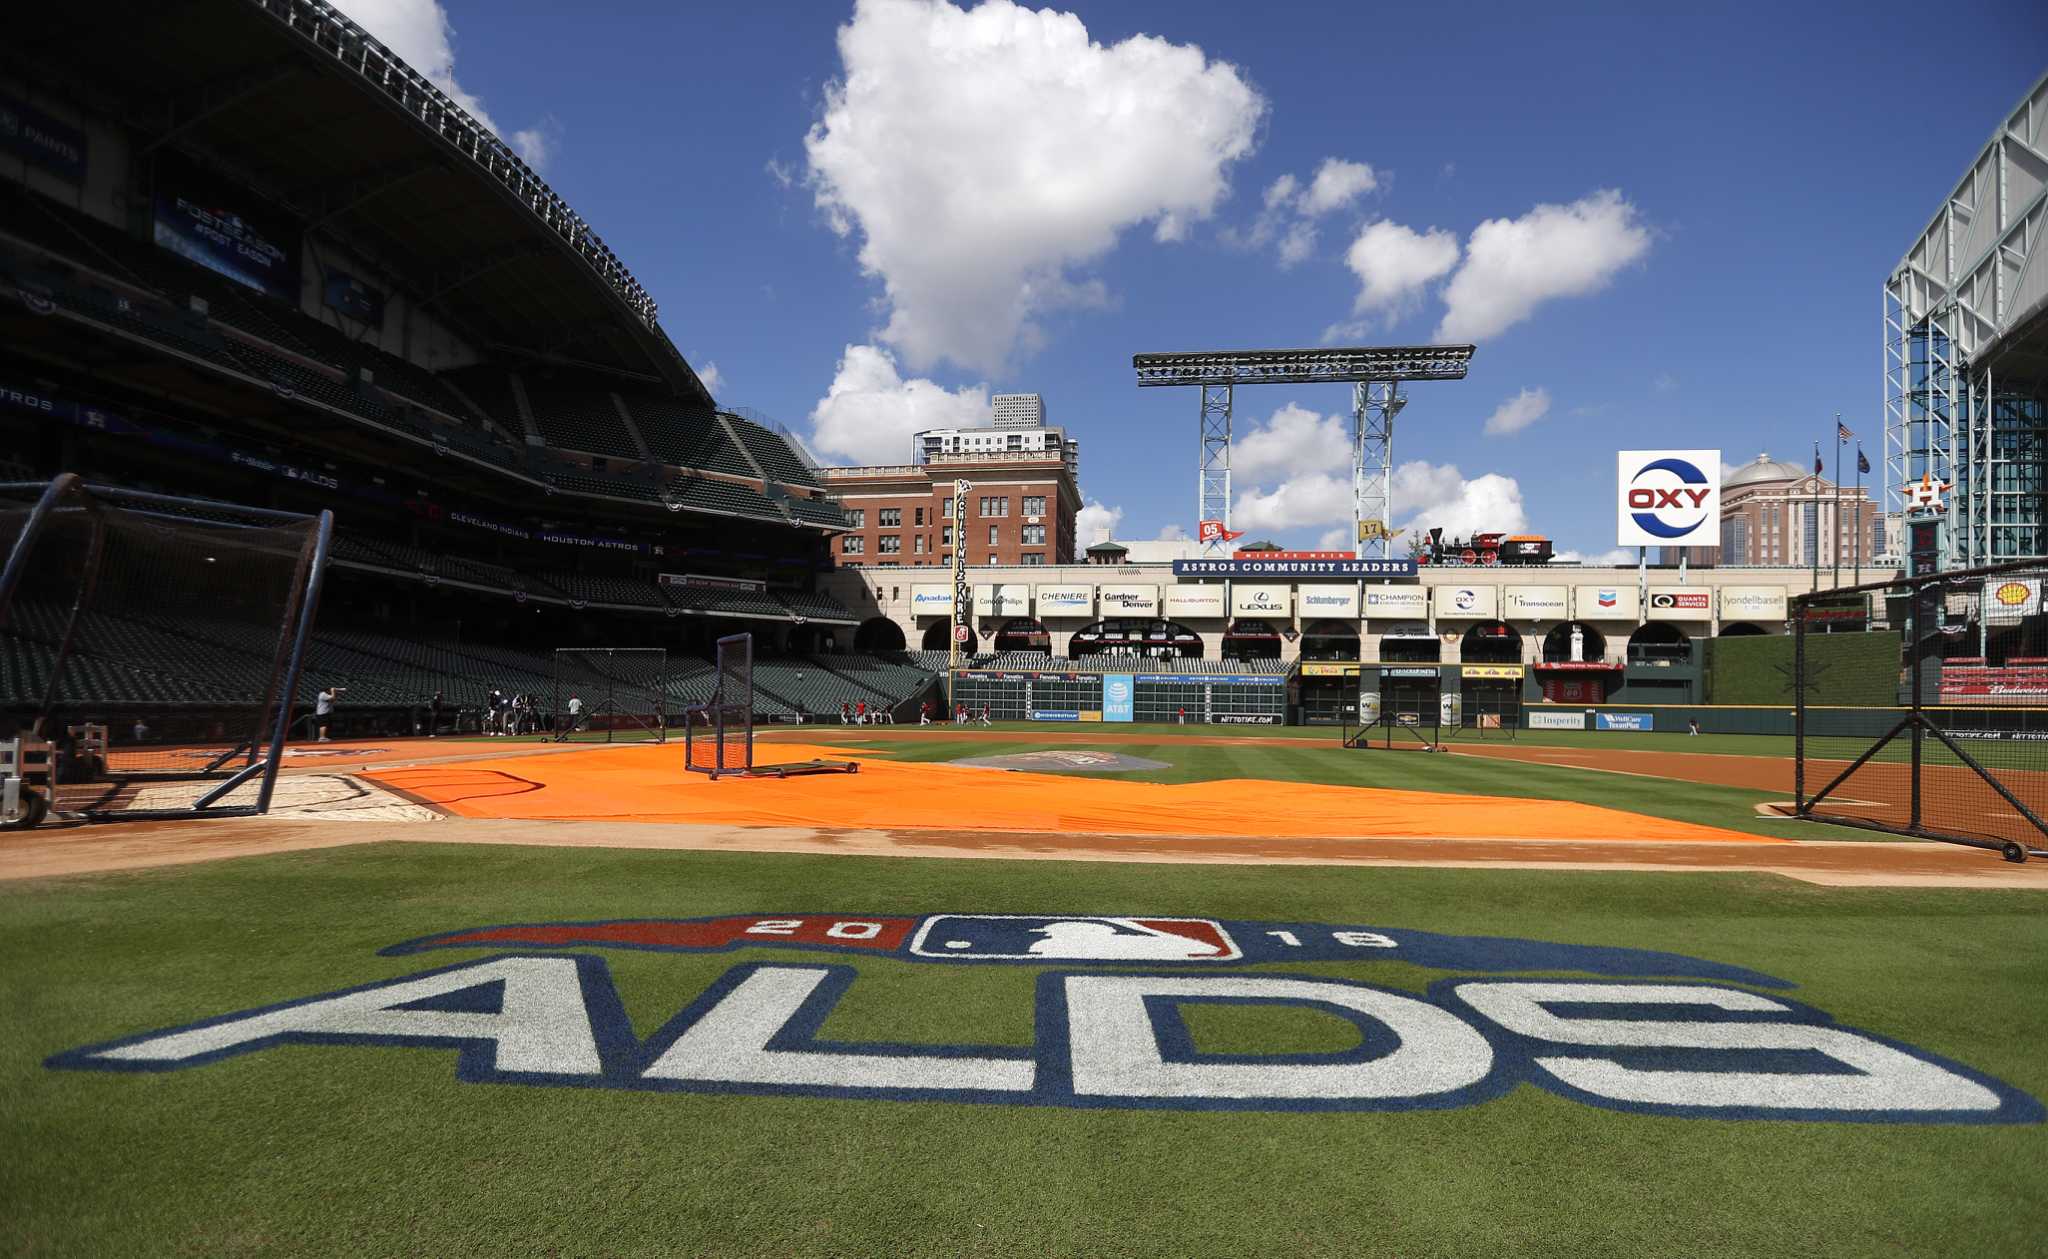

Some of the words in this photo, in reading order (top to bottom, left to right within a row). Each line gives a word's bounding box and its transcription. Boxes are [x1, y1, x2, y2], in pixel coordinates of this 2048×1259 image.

[1628, 488, 1712, 509] OXY
[451, 511, 497, 531] CLEVELAND
[1204, 523, 1218, 536] 05
[1364, 523, 1377, 535] 17
[543, 535, 595, 546] HOUSTON
[597, 540, 640, 551] ASTROS
[1182, 562, 1236, 572] ASTROS
[1242, 562, 1336, 573] COMMUNITY
[1342, 562, 1409, 573] LEADERS
[914, 594, 951, 602] Anadar
[1041, 592, 1089, 601] CHENIERE
[1104, 593, 1140, 601] Gardner
[1122, 600, 1154, 608] Denver
[1990, 685, 2048, 694] Budweiser
[1106, 705, 1129, 713] AT&T
[1221, 716, 1273, 724] NITTOTIRE.COM
[1543, 717, 1580, 725] Insperity
[746, 919, 882, 939] 20
[1266, 930, 1399, 948] 18
[98, 956, 2002, 1112] ALDS
